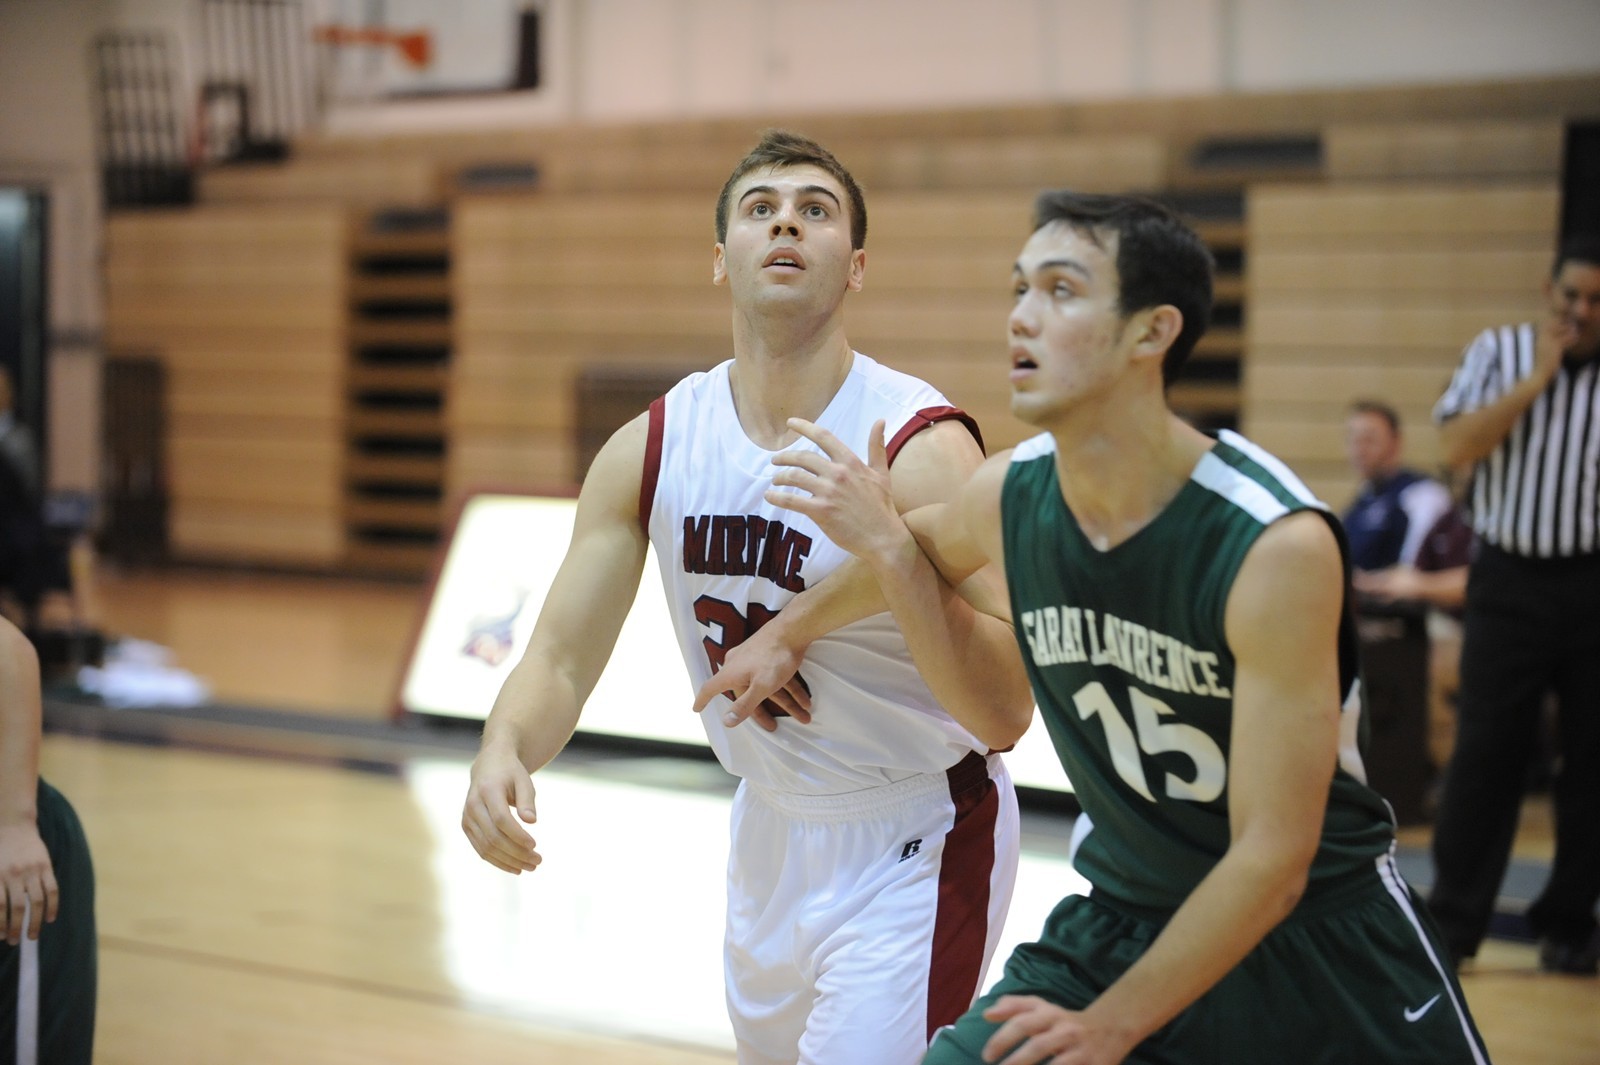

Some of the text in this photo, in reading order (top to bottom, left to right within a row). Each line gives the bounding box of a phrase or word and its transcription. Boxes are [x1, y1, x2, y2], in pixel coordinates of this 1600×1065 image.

[693, 594, 812, 718] 2
[1021, 604, 1233, 699] SARAH LAWRENCE
[1071, 681, 1227, 804] 15
